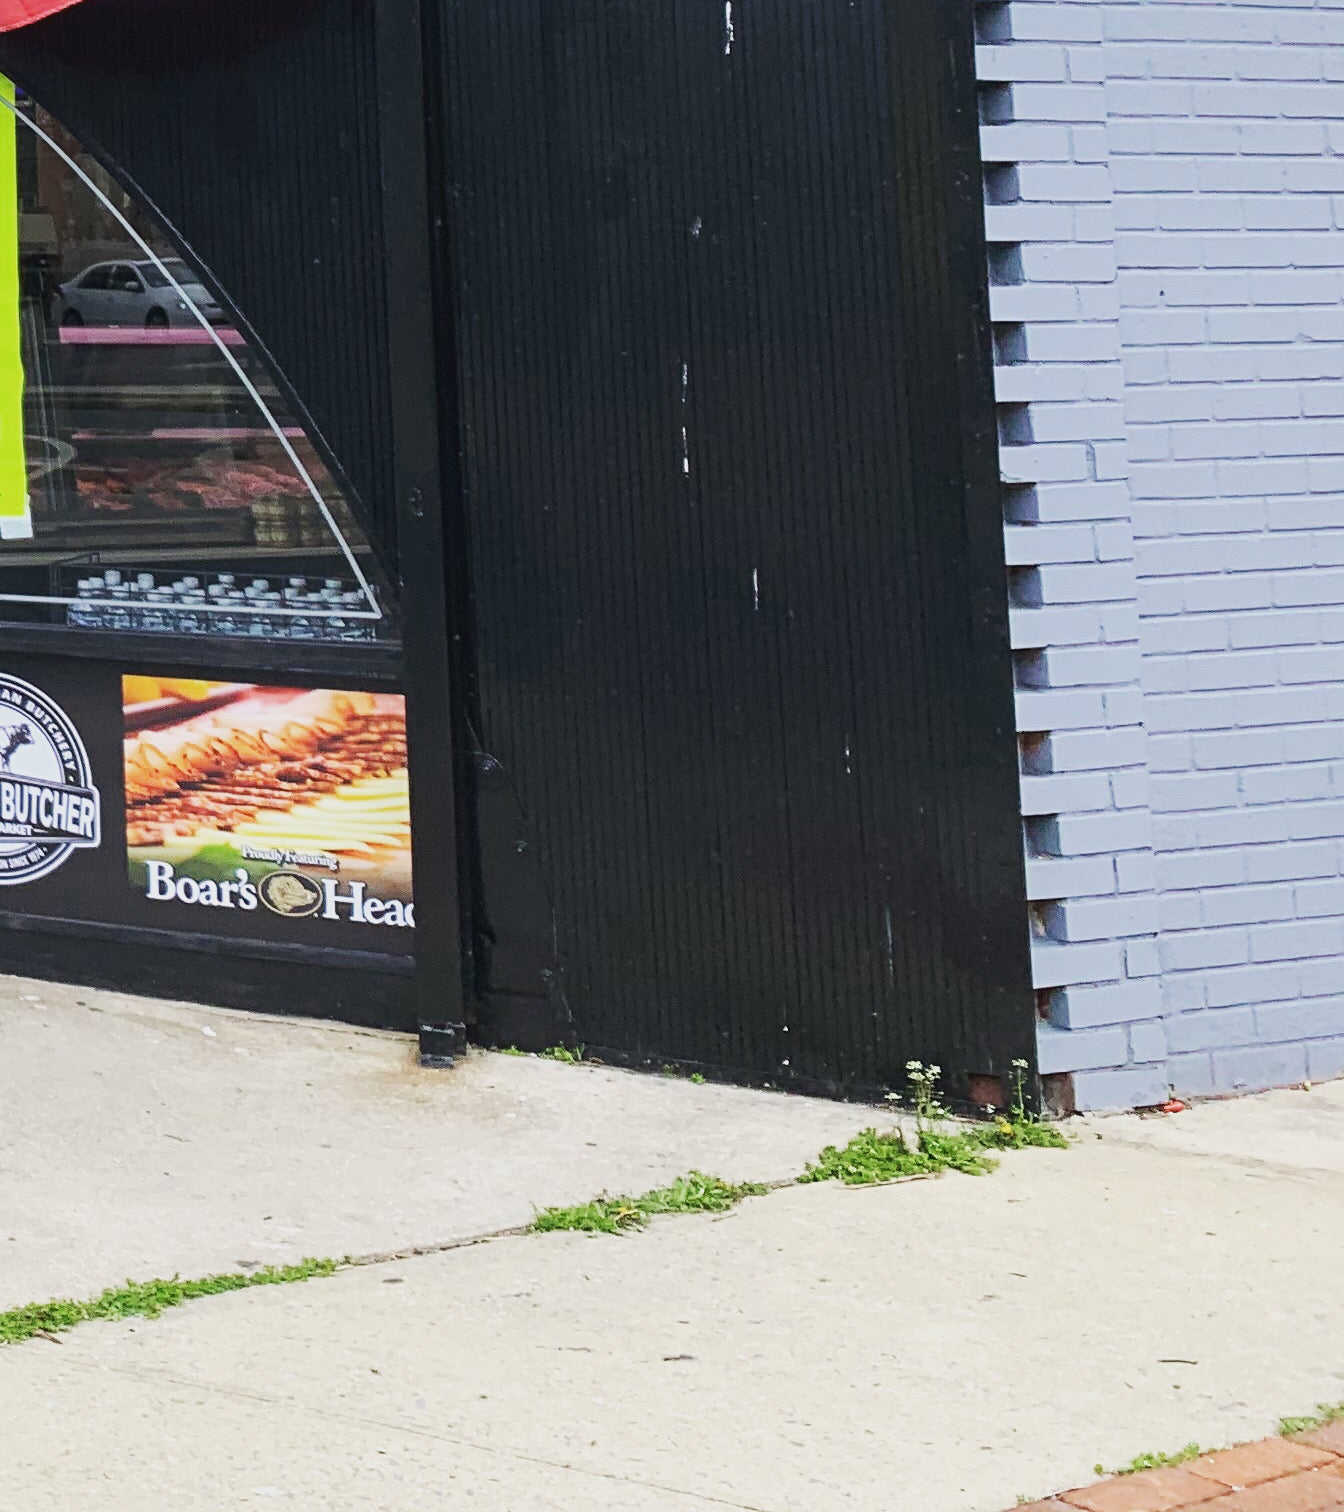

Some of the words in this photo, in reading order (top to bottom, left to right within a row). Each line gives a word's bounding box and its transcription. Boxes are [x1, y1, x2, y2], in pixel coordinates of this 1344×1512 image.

[25, 699, 76, 771] BUTCHERY
[0, 782, 95, 838] BUTCHER
[145, 860, 258, 910] Boar's
[241, 845, 288, 864] Proudly
[286, 849, 340, 873] Featuring
